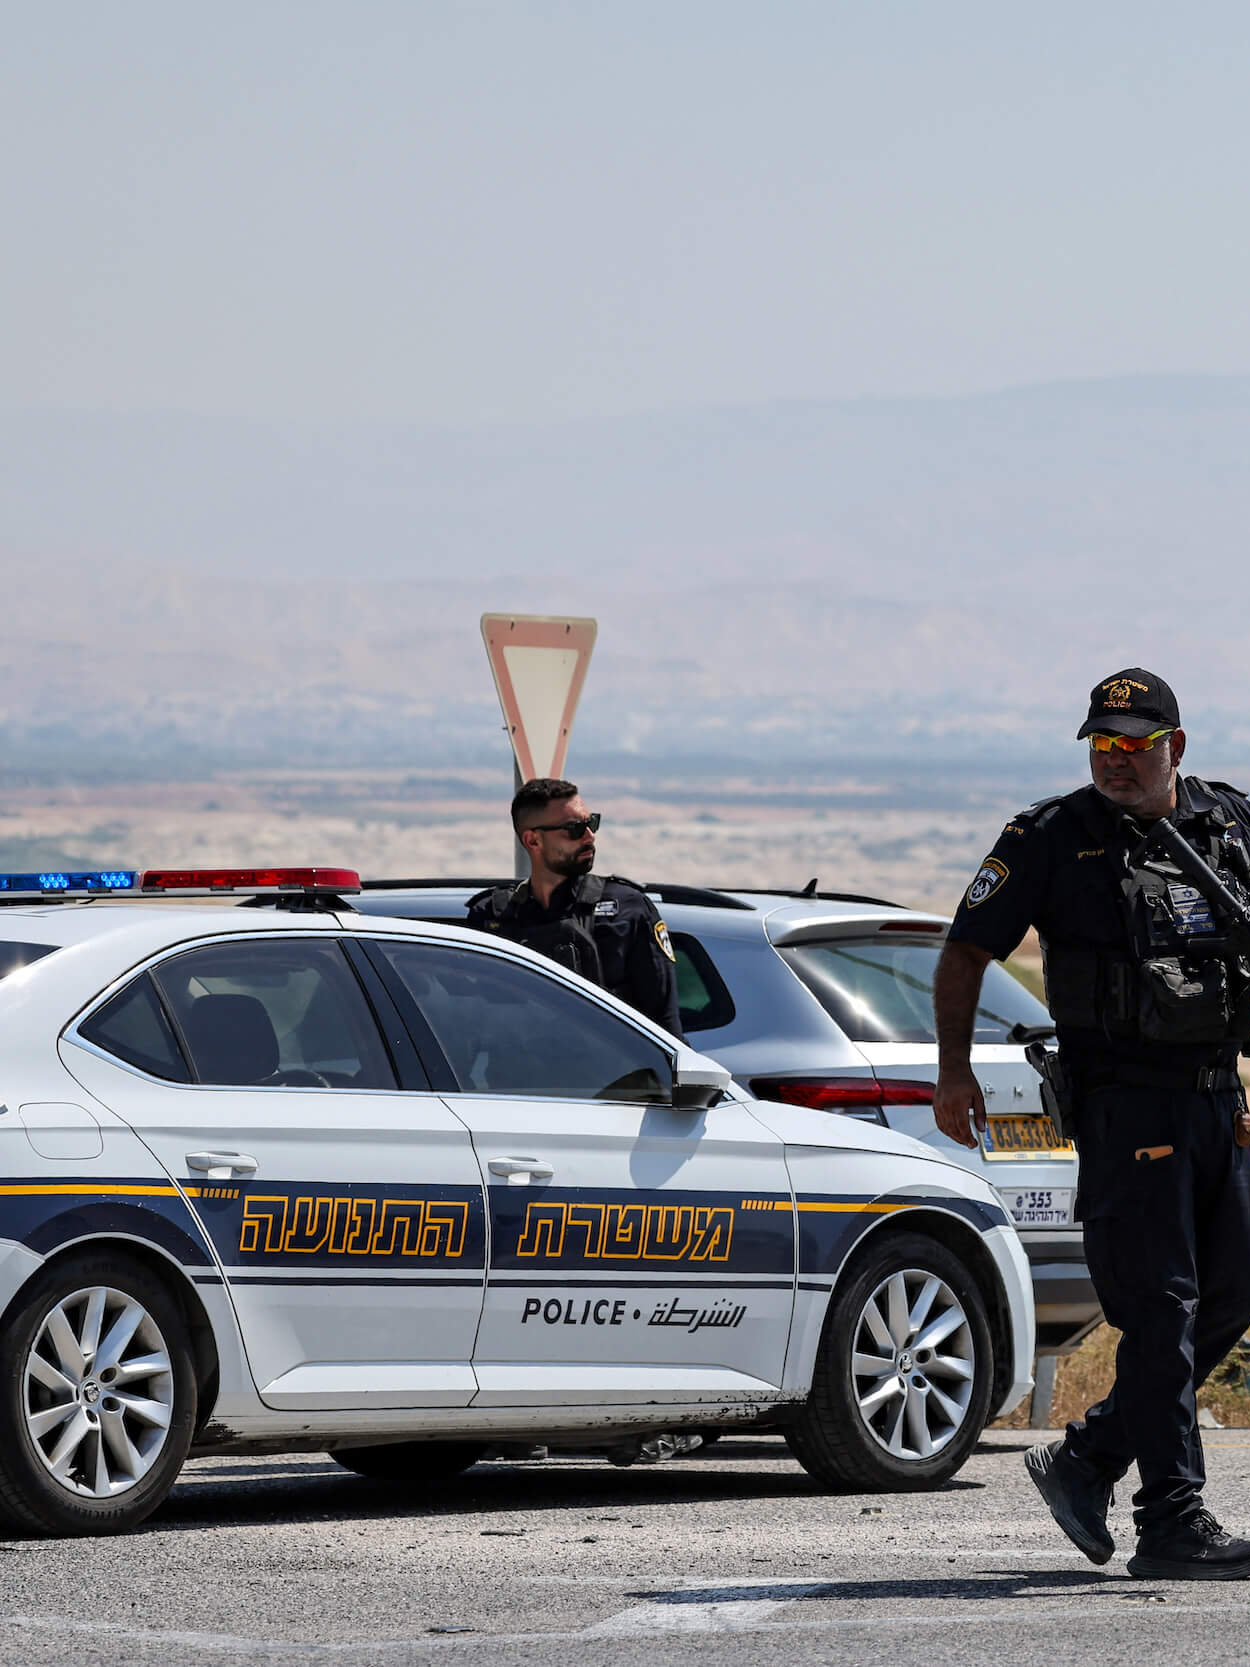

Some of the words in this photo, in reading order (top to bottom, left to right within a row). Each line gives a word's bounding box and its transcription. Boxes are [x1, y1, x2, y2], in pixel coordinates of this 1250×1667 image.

[239, 1196, 469, 1258] התנועה
[517, 1202, 735, 1262] משטרת
[522, 1298, 626, 1325] POLICE
[648, 1298, 747, 1333] الشرطة
